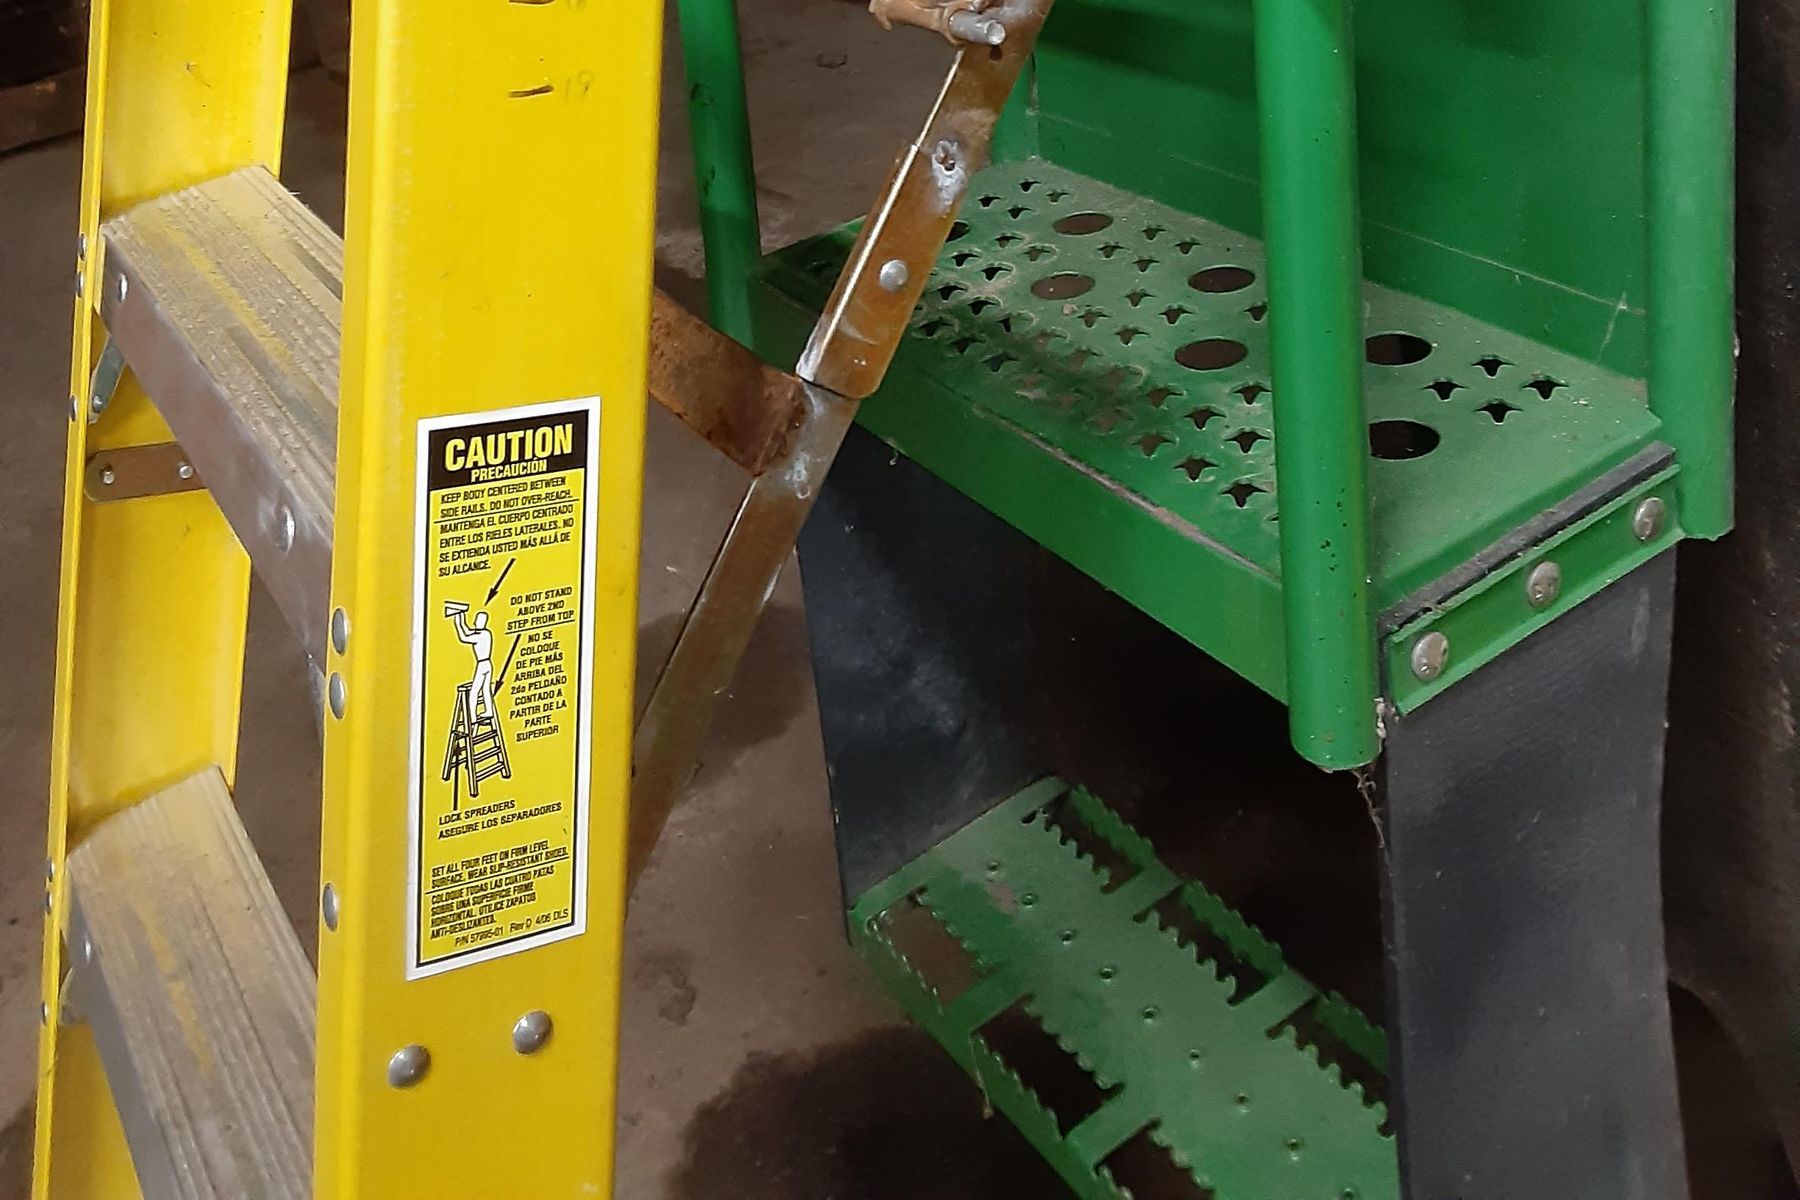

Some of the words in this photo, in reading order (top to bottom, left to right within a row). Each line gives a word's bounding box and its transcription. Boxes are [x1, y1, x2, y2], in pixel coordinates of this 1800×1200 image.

[445, 423, 573, 471] CAUTION
[471, 457, 548, 482] PRECAUCIÓN
[441, 492, 461, 504] KEEP
[464, 489, 485, 500] BODY
[488, 482, 527, 496] CENTERED
[530, 476, 566, 490] BETWEEN
[441, 507, 459, 518] SIDE
[461, 504, 487, 515] RAILS.
[490, 500, 501, 510] DO
[504, 498, 518, 508] NOT
[522, 489, 573, 505] OVER-REACH.
[440, 518, 485, 534] MANTENGA
[488, 517, 496, 526] EL
[498, 511, 530, 524] CUERPO
[532, 504, 573, 519] CENTRADO
[440, 536, 465, 548] ENTRE
[468, 533, 483, 544] LOS
[486, 528, 512, 541] RIELES
[515, 522, 560, 536] LATERALES.
[563, 518, 574, 528] NO
[440, 552, 449, 562] SE
[452, 546, 490, 561] EXTIENDA
[492, 541, 518, 554] USTED
[520, 538, 537, 549] MÁS
[540, 532, 558, 546] ALLÁ
[560, 532, 571, 542] DE
[439, 566, 450, 577] SU
[452, 560, 491, 575] ALCANCE.
[511, 596, 522, 605] DO
[526, 592, 542, 602] NOT
[545, 587, 572, 599] STAND
[518, 603, 545, 616] ABOVE
[548, 600, 564, 610] 2ND
[507, 619, 528, 630] STEP
[531, 614, 555, 625] FROM
[558, 610, 574, 620] TOP
[528, 633, 540, 643] NO
[542, 630, 553, 640] SE
[516, 660, 527, 669] DE
[530, 657, 542, 667] PIE
[545, 651, 563, 663] MÁS
[520, 641, 560, 656] COLOQUE
[514, 668, 546, 682] ARRIBA
[548, 665, 564, 674] DEL
[528, 675, 567, 691] PELDAÑO
[515, 690, 555, 706] CONTADO
[557, 688, 562, 697] A
[510, 705, 540, 719] PARTIR
[543, 702, 554, 712] DE
[556, 700, 567, 709] LA
[516, 725, 559, 741] SUPERIOR
[525, 715, 551, 728] PARTE
[438, 822, 479, 839] ASEGURE
[482, 818, 498, 829] LOS
[501, 802, 562, 824] SEPARADORES
[439, 813, 462, 825] LOCK
[464, 800, 515, 819] SPREADERS
[432, 866, 444, 877] SET
[446, 863, 459, 874] ALL
[462, 858, 480, 870] FOUR
[482, 853, 498, 865] FEET
[500, 850, 509, 859] ON
[511, 845, 528, 858] FIRM
[529, 840, 549, 853] LEVEL
[468, 867, 487, 879] WEAR
[490, 852, 543, 874] SLIP-RESISTANT
[432, 890, 464, 905] COLOQUE
[466, 882, 488, 895] TODAS
[490, 878, 503, 888] LAS
[505, 871, 531, 885] CUATRO
[533, 865, 554, 878] PATAS
[431, 903, 454, 916] SOBRE
[456, 899, 470, 910] UNA
[472, 887, 512, 906] SUPERFICIE
[513, 882, 534, 894] FIRME
[479, 901, 504, 915] UTILICE
[506, 892, 536, 907] ZAPATOS
